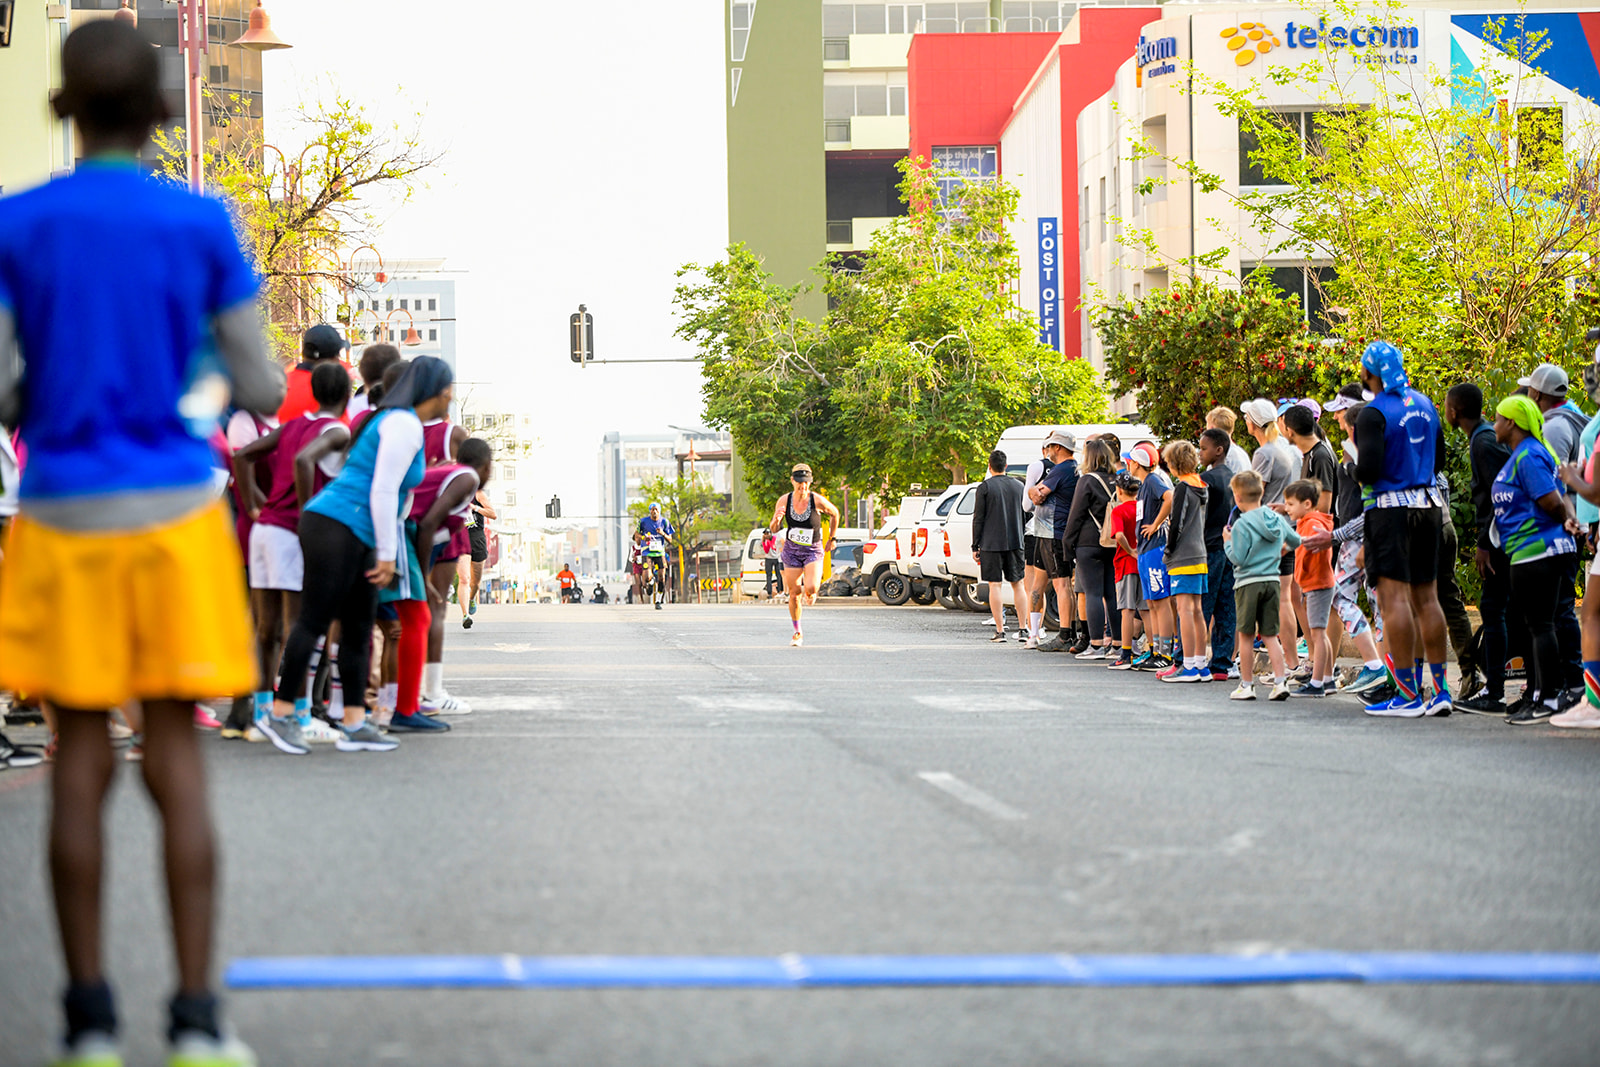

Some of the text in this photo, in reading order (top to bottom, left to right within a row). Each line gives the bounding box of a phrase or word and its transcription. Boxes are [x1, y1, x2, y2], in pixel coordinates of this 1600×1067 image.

[1285, 18, 1419, 48] telecom
[1041, 222, 1054, 281] POST
[796, 535, 810, 543] 352
